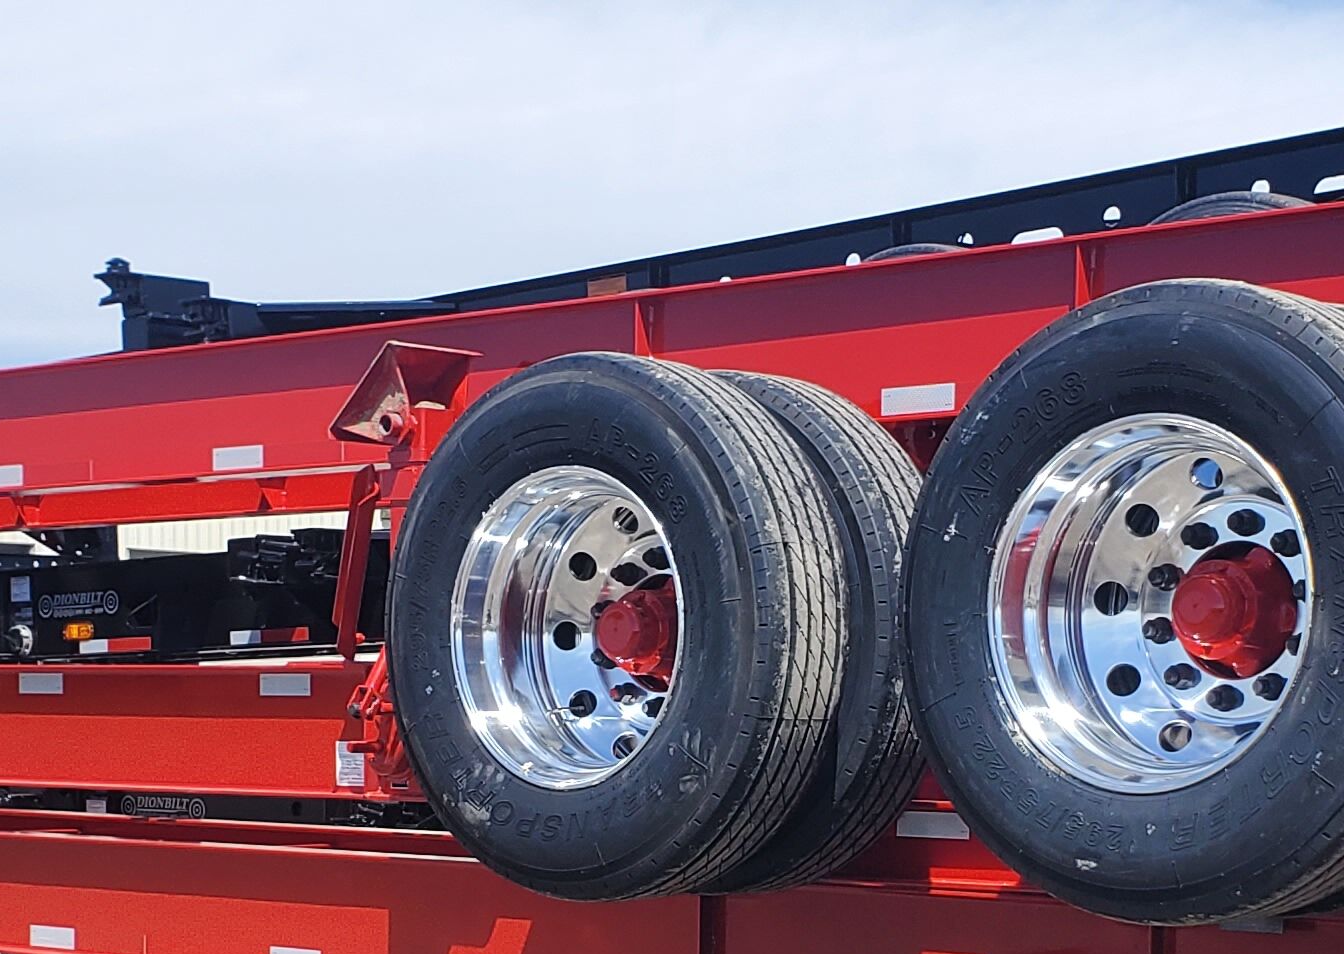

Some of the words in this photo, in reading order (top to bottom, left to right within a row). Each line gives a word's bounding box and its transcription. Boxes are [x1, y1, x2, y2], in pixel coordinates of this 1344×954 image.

[585, 416, 690, 524] AP-268
[959, 369, 1089, 518] AP-268
[53, 591, 104, 605] DIONBILT
[137, 796, 189, 810] DIONBILT
